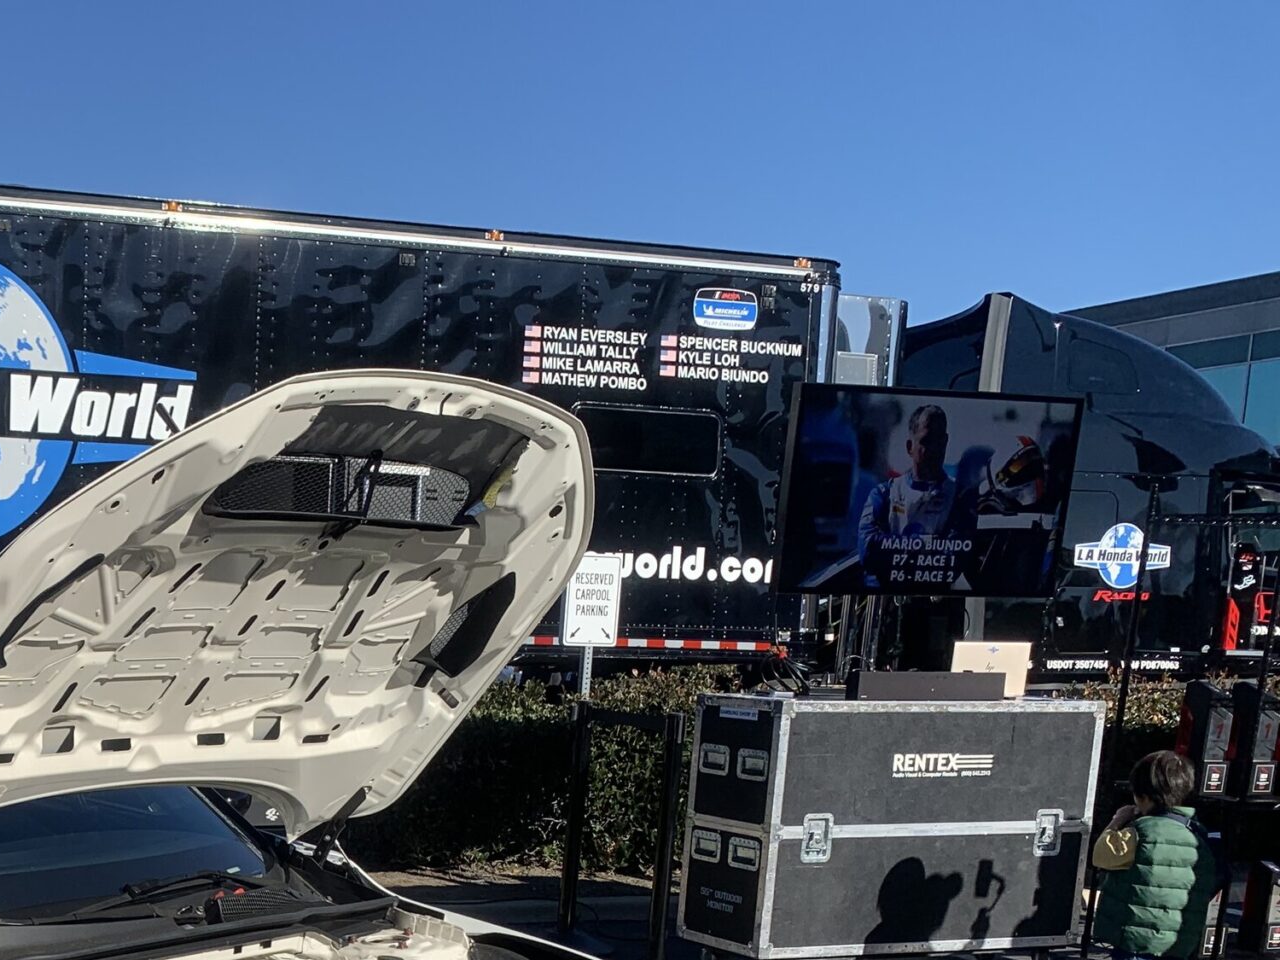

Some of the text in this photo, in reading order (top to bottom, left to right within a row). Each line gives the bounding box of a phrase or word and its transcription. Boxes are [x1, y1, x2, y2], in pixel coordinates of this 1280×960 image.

[543, 326, 648, 346] RYAN EVERSLEY
[542, 341, 638, 360] WILLIAM TALLY
[679, 336, 802, 357] SPENCER BUCKNUM
[678, 350, 740, 367] KYLE LOH
[542, 356, 639, 376] MIKE LAMARRA
[541, 371, 648, 391] MATHEW POMBO
[677, 365, 769, 384] MARIO BIUNDO
[9, 373, 195, 441] World
[881, 538, 972, 552] MARIO BIUNDO
[892, 554, 908, 566] P7
[917, 555, 947, 567] RACE
[950, 555, 955, 567] 1
[1097, 549, 1133, 561] Honda
[575, 572, 614, 586] RESERVED
[890, 570, 905, 581] P6
[914, 571, 944, 582] RACE
[946, 571, 954, 582] 2
[575, 588, 611, 602] CARPOOL
[1093, 590, 1151, 602] RACIG
[575, 605, 609, 617] PARKING
[1047, 660, 1073, 670] USDOT
[892, 753, 959, 771] RENTEX
[714, 890, 743, 904] OUTDOOR
